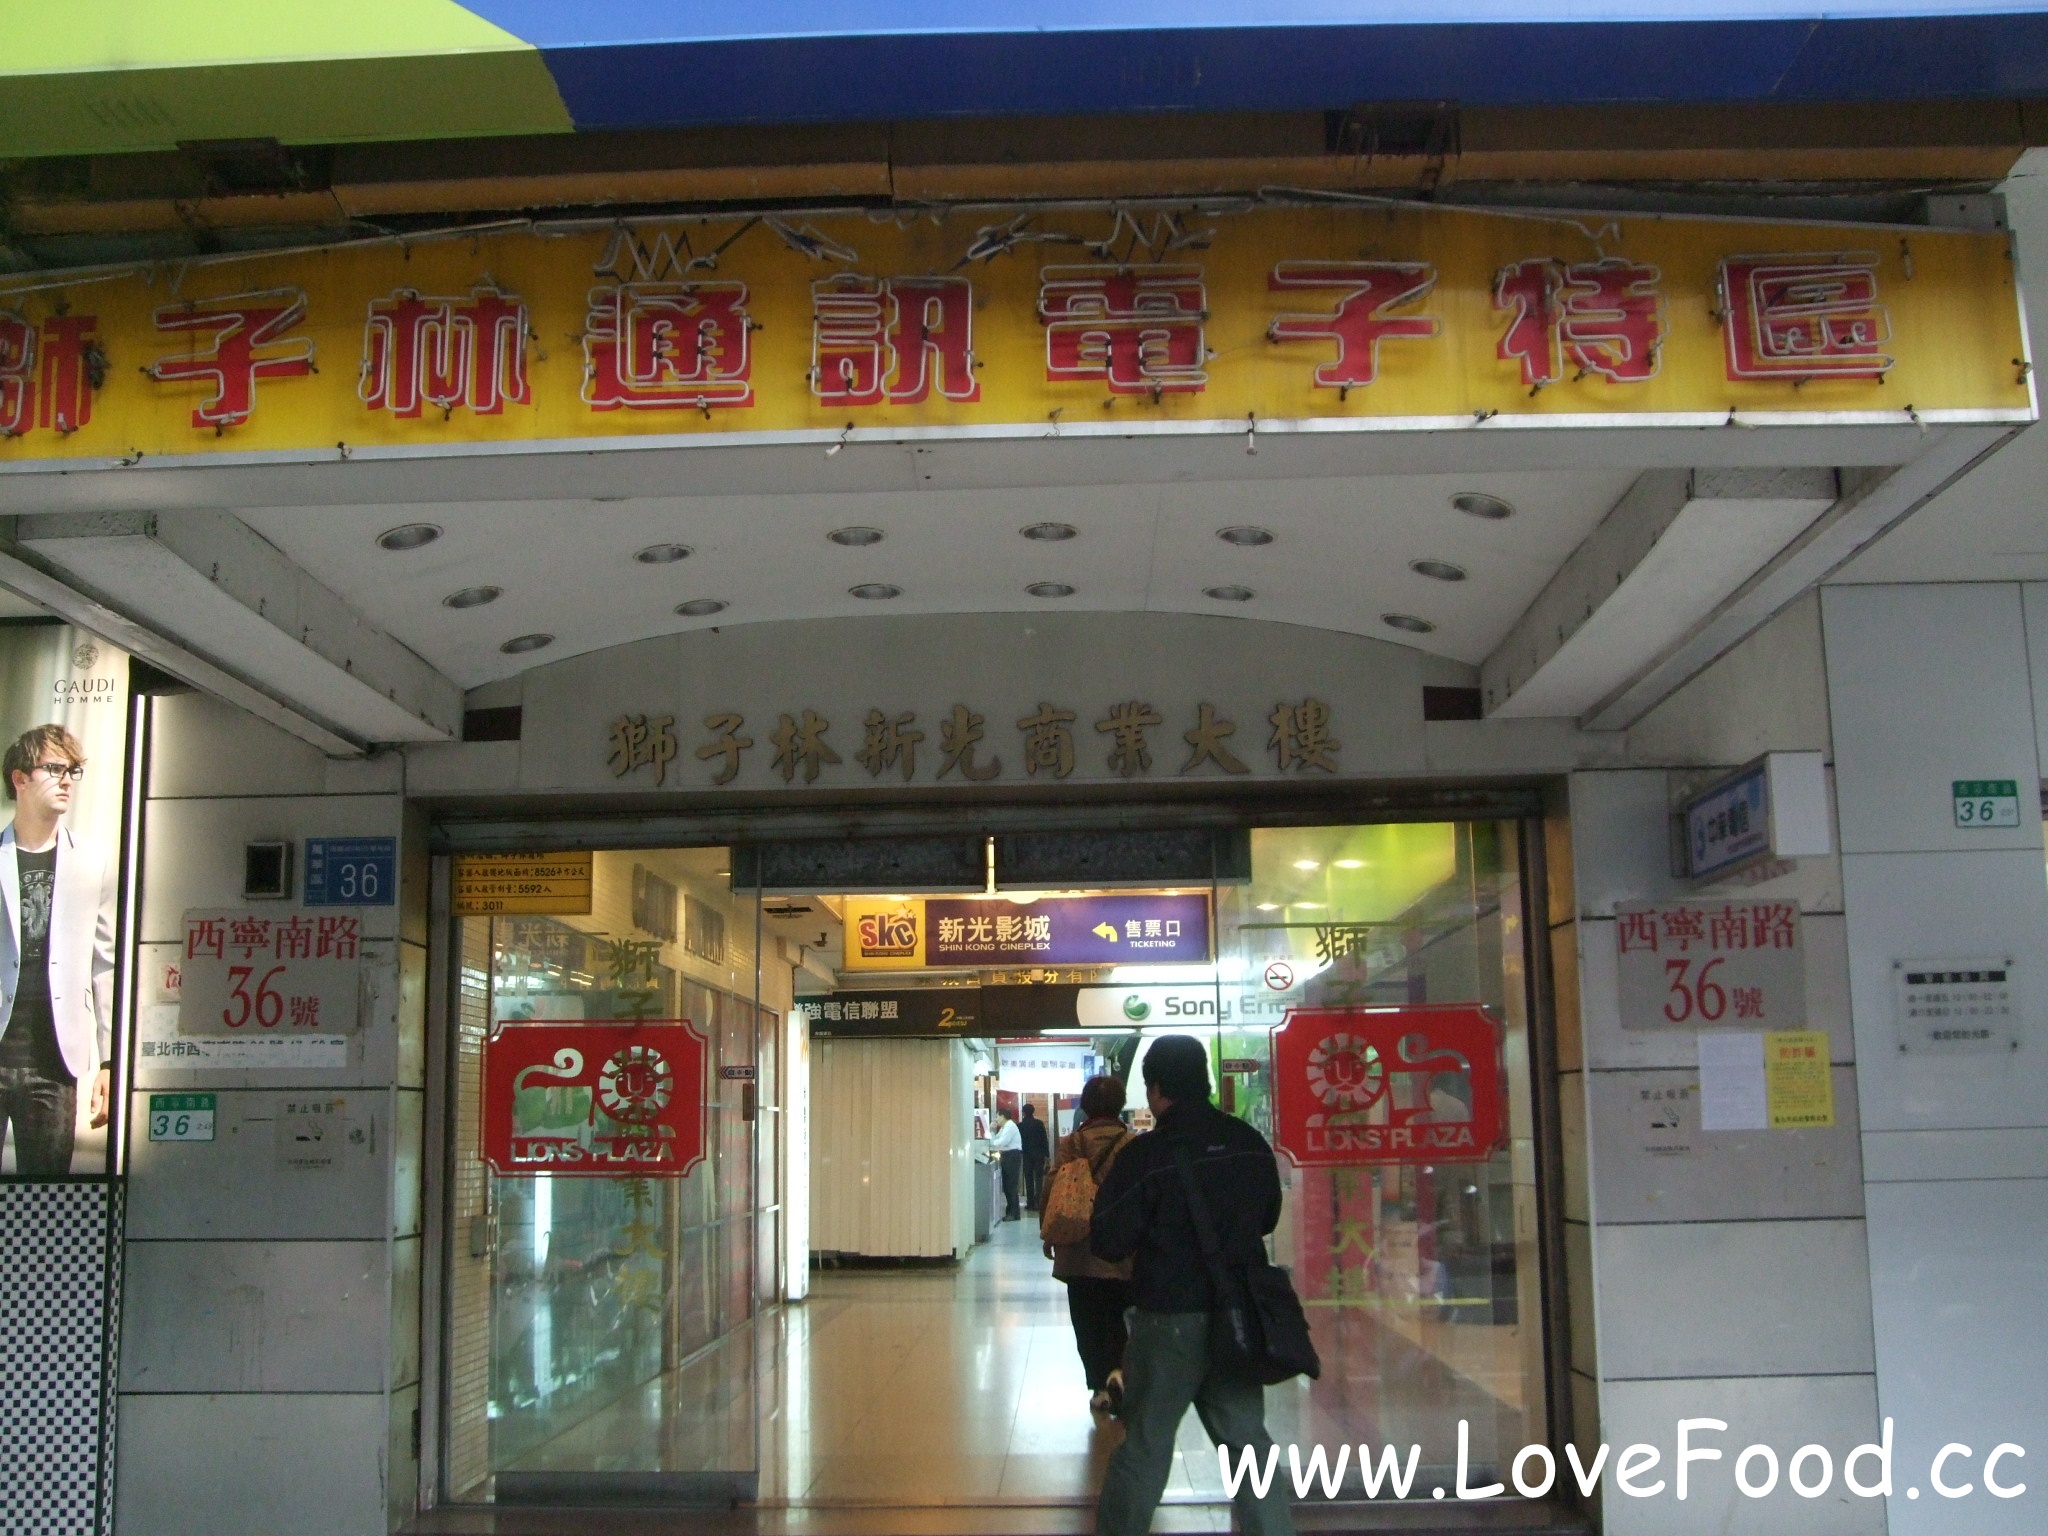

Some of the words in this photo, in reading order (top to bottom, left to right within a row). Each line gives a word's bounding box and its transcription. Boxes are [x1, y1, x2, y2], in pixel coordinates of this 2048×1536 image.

[54, 678, 115, 694] GAUDI
[54, 695, 113, 704] HOMME
[606, 698, 1342, 786] 獅子林新光商業大樓
[1960, 800, 1994, 822] 36
[341, 863, 378, 898] 36
[187, 914, 360, 960] 西寧南路
[938, 915, 1051, 943] 新光影城
[1124, 918, 1181, 939] 售票口
[1618, 903, 1795, 954] 西寧南路
[939, 944, 963, 952] SHIN
[965, 943, 995, 951] KONG
[1000, 942, 1051, 951] CINEPLEX
[1129, 940, 1176, 949] TICKETING
[223, 965, 320, 1029] 36號
[1663, 957, 1765, 1022] 36號
[1165, 996, 1232, 1019] Sony
[153, 1114, 191, 1136] 36
[1391, 1126, 1476, 1149] PLAZA
[592, 1142, 675, 1162] PLAZA
